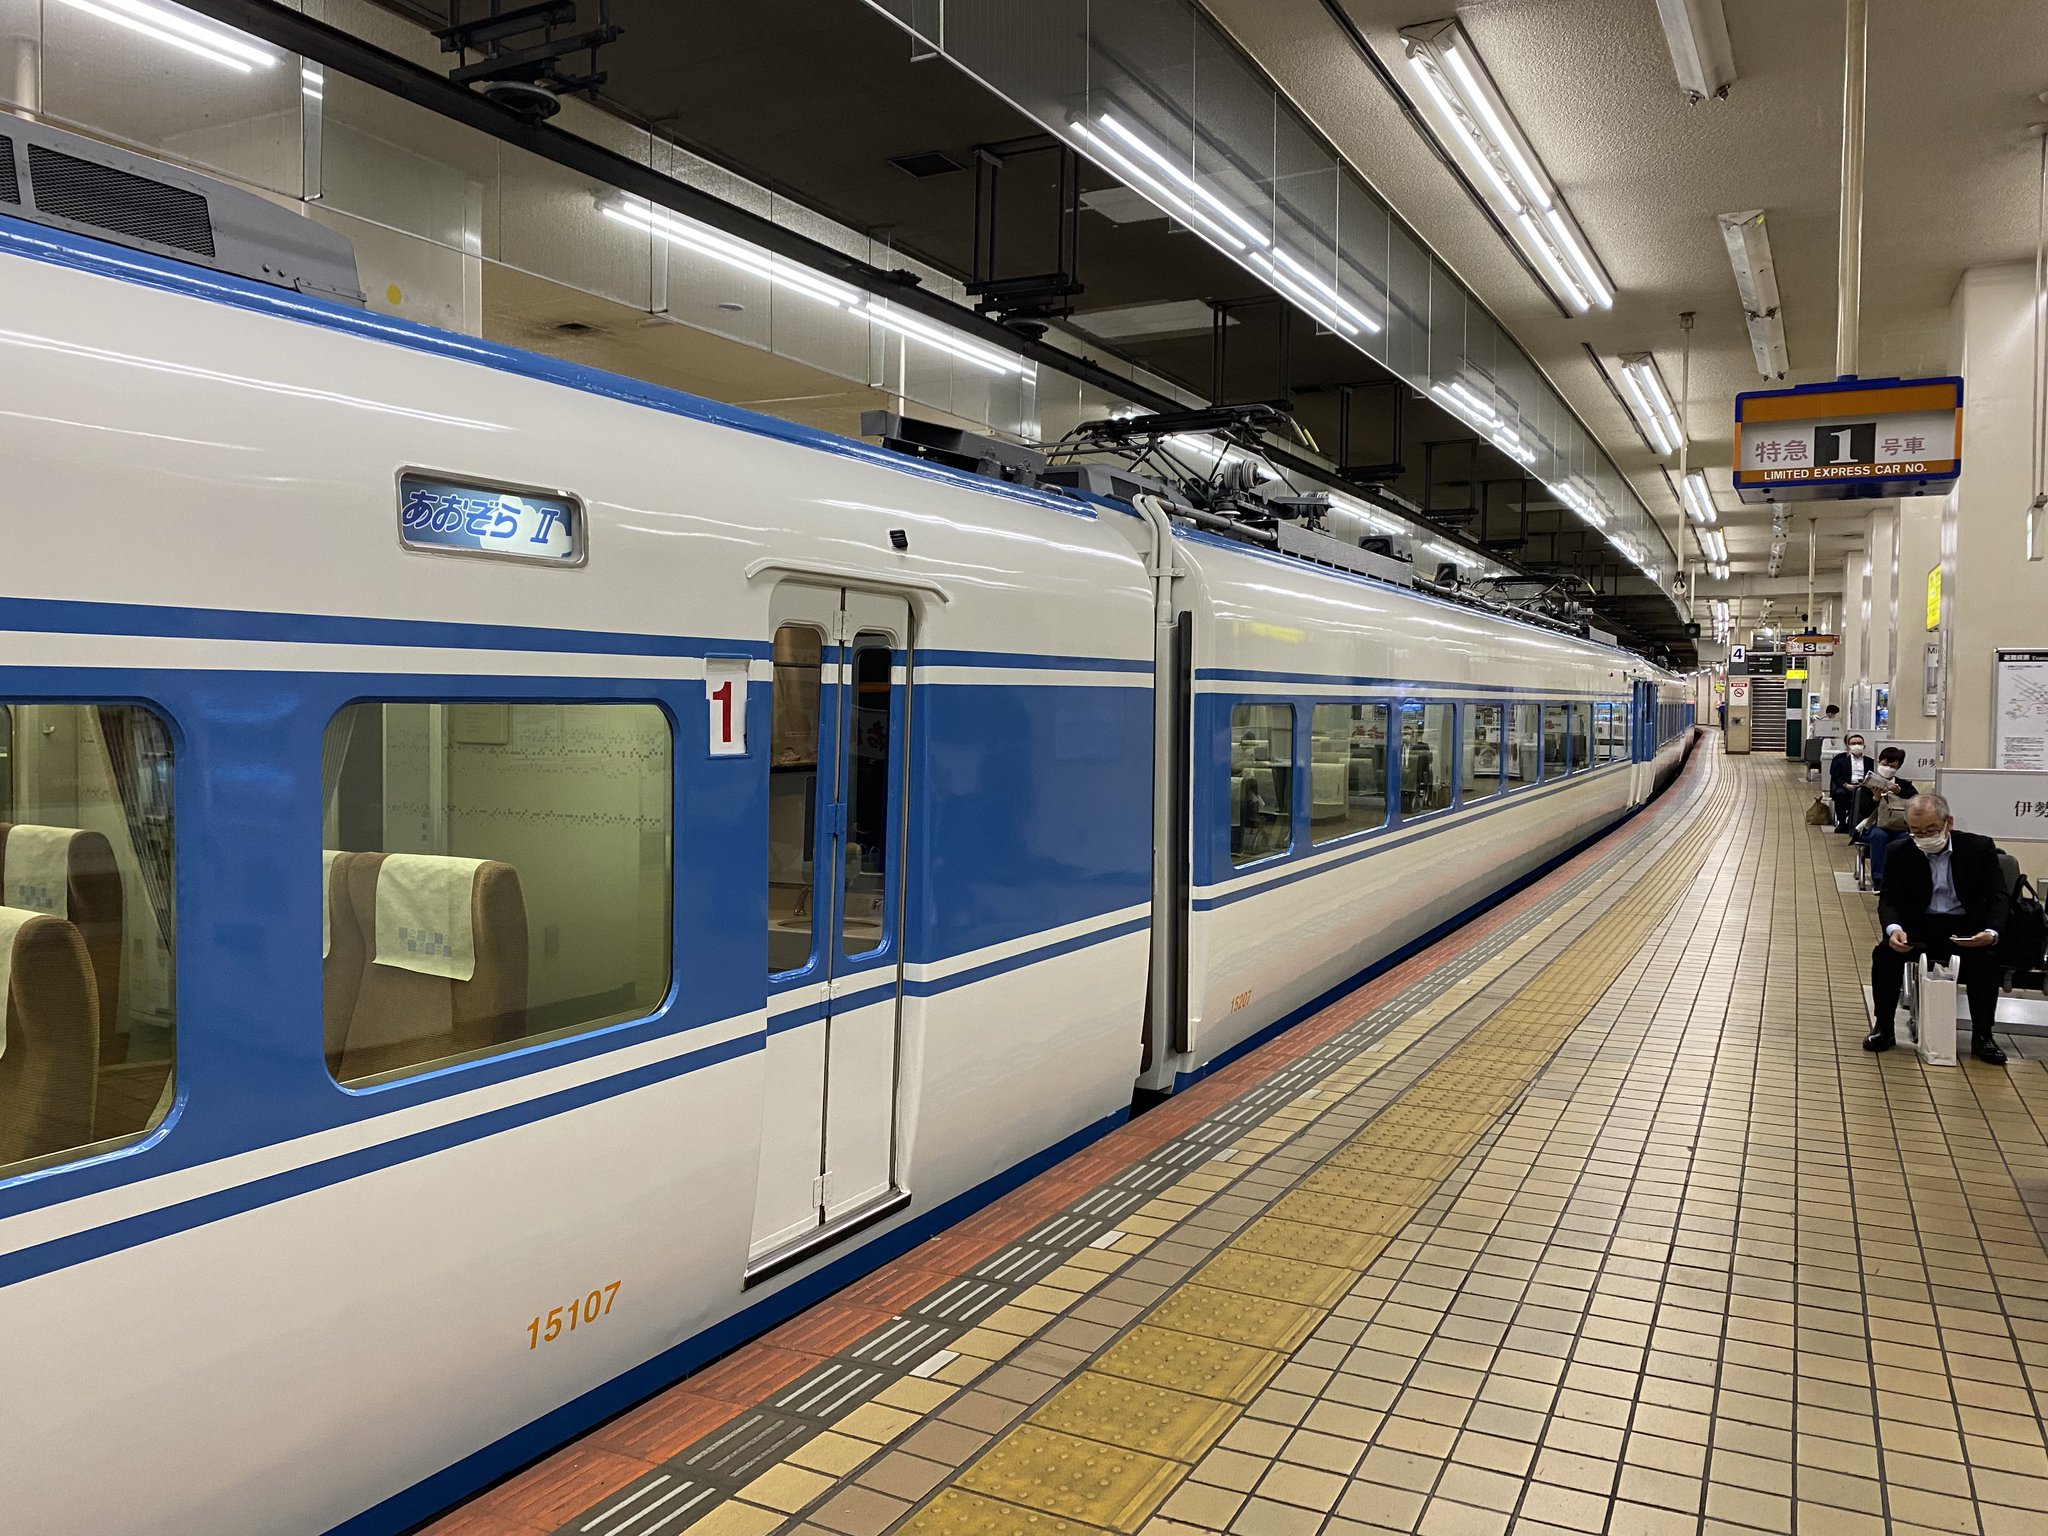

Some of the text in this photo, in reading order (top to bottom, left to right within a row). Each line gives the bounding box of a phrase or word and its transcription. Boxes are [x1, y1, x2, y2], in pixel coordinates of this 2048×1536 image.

[1755, 428, 1925, 464] 特急 1 号車
[1764, 462, 1927, 481] LIMITED EXPRESS CAR NO.
[402, 489, 522, 539] あおぞら
[1732, 648, 1744, 660] 4
[1804, 643, 1816, 652] 3
[712, 681, 732, 743] 1
[526, 1279, 622, 1351] 15107
